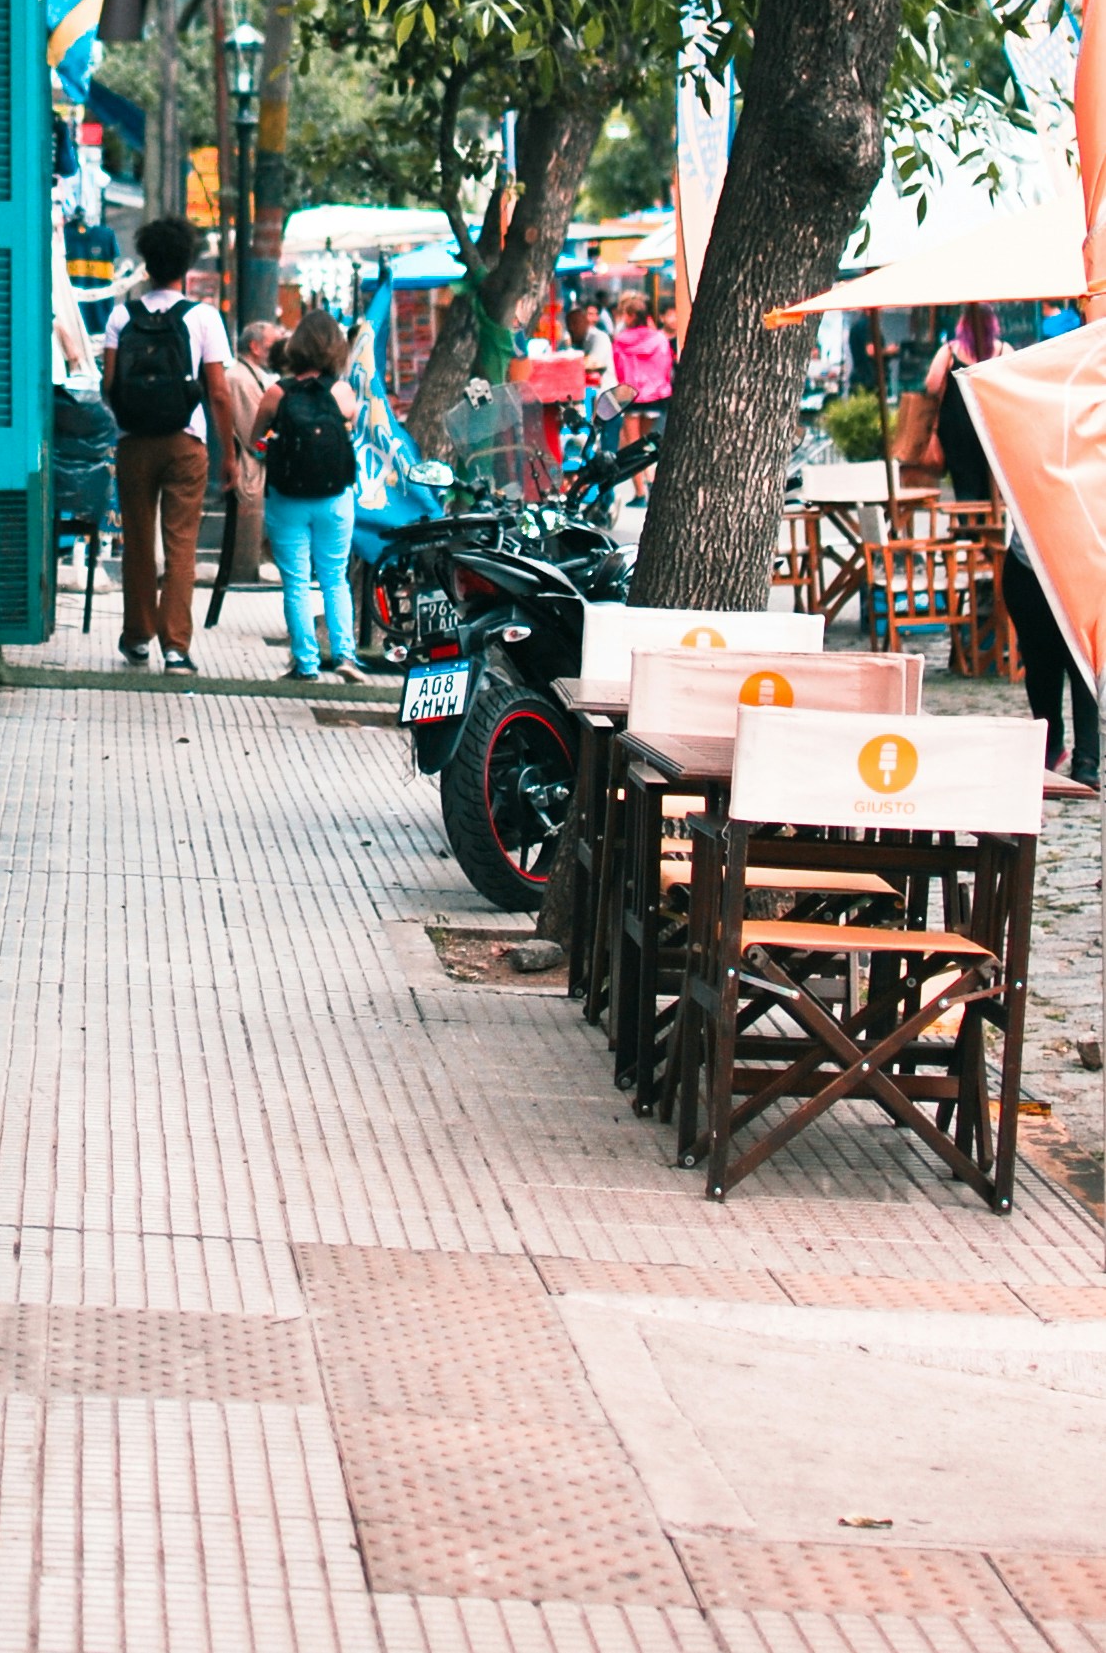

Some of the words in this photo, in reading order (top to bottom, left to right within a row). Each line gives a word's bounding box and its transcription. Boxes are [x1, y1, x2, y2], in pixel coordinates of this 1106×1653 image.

[419, 675, 454, 697] A08
[409, 695, 458, 719] 6MWW
[854, 800, 916, 815] GIUSTO
